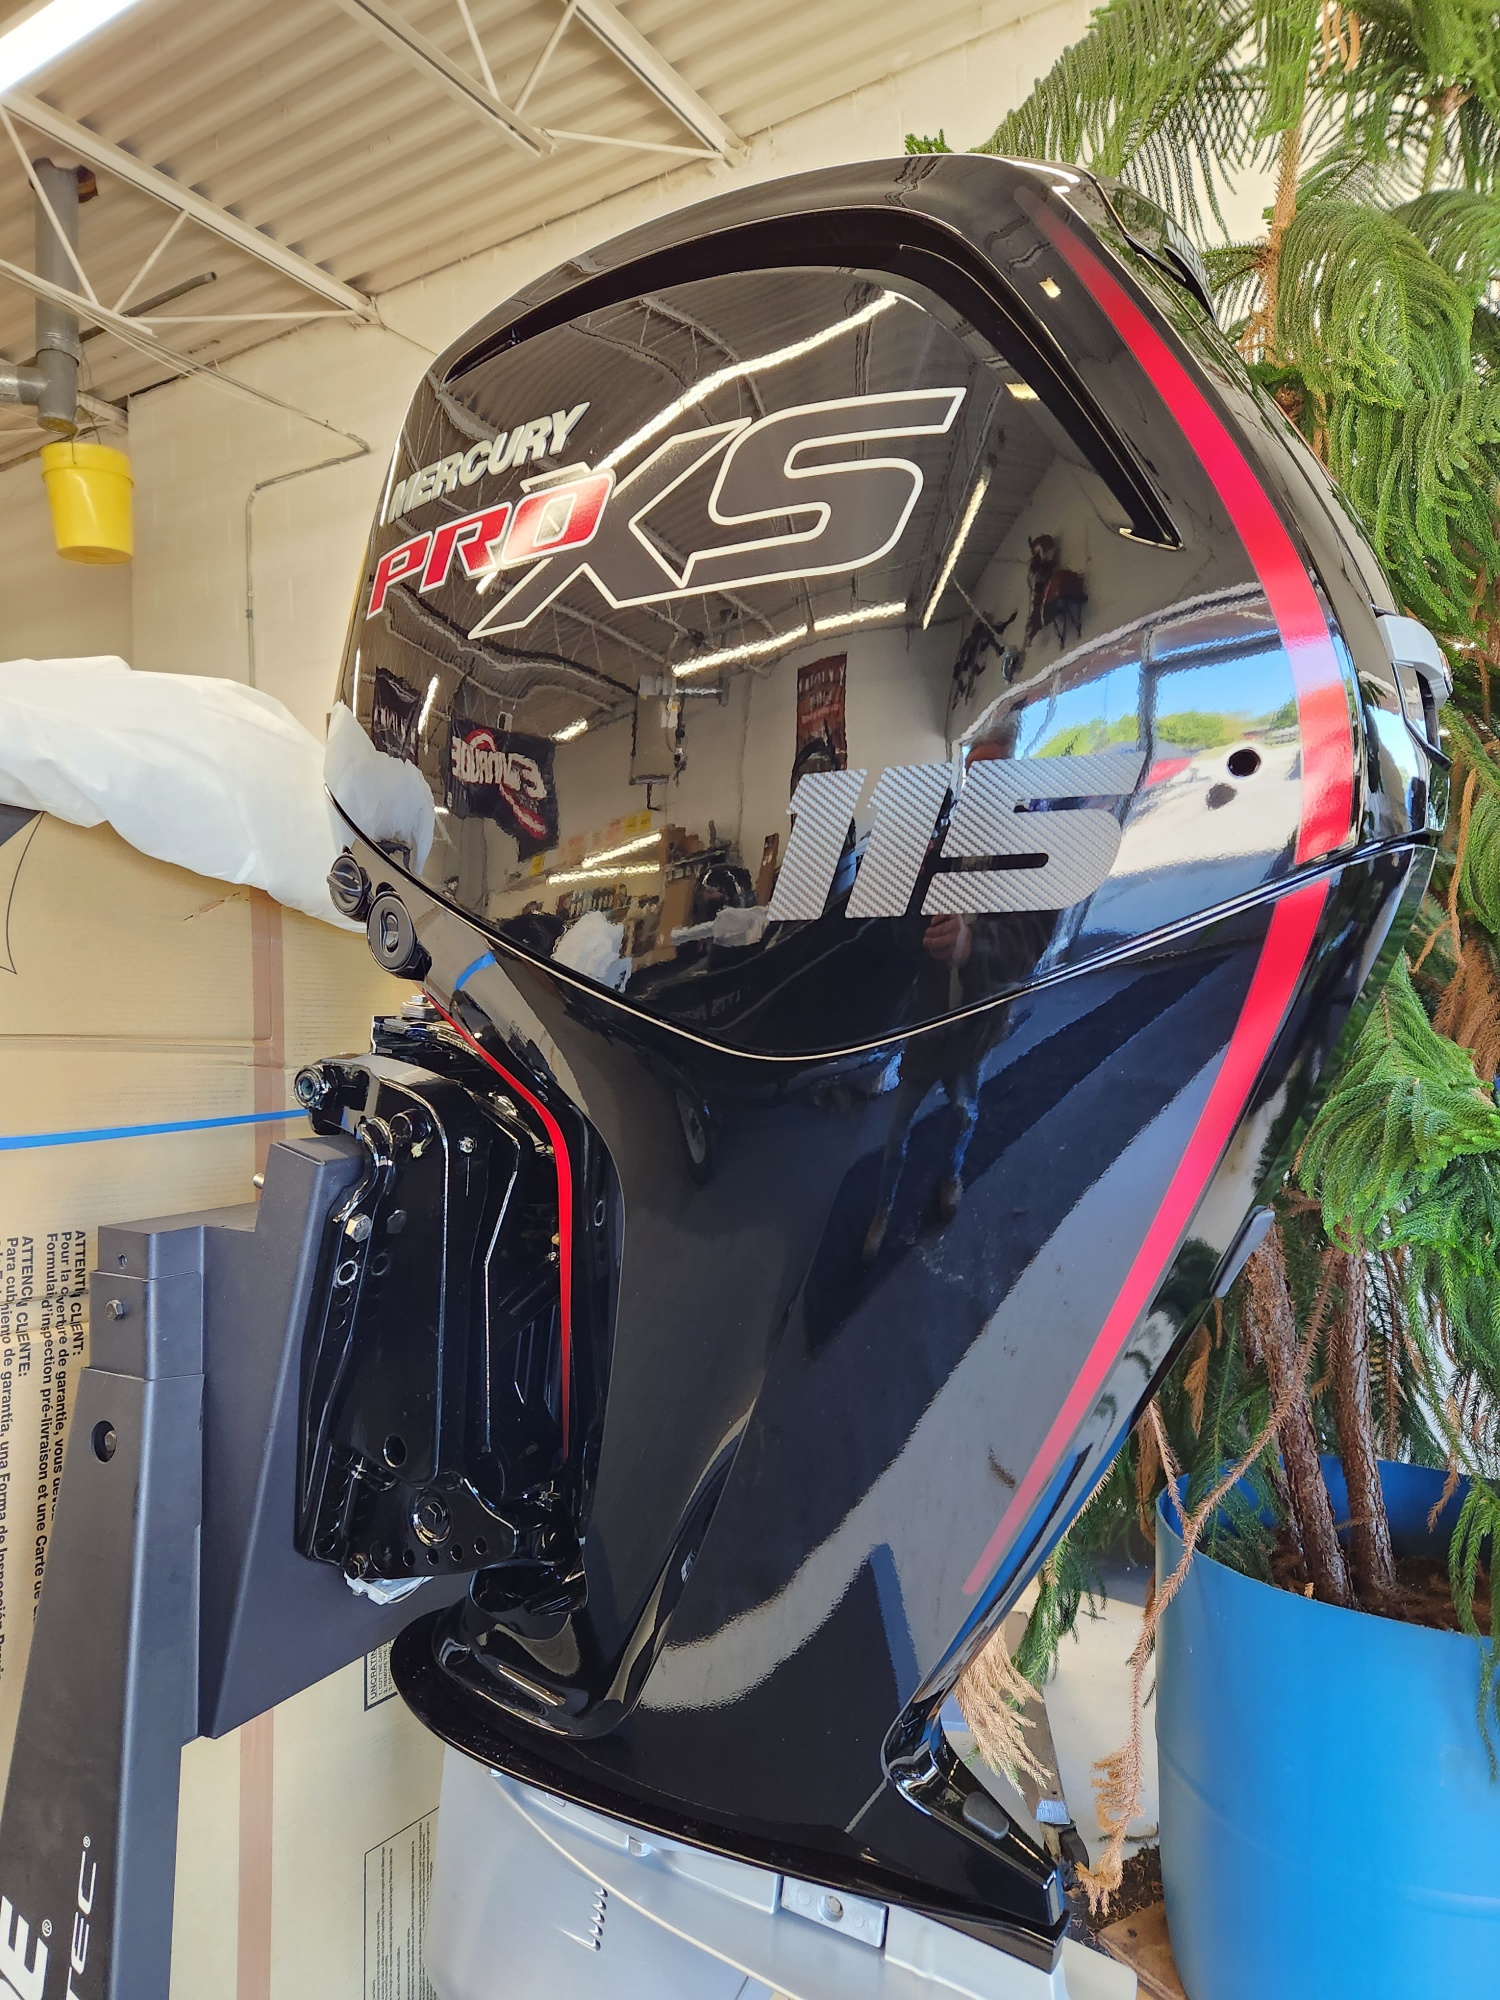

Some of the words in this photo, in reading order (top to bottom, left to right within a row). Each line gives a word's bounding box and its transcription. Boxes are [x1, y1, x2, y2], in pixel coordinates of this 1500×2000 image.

[388, 401, 591, 524] MERCURY
[467, 386, 968, 640] XS
[366, 472, 613, 621] PRO
[766, 751, 1148, 922] 115
[6, 1237, 19, 1272] Para
[60, 1231, 73, 1265] Pour
[69, 1230, 86, 1298] ATTENTIN
[60, 1269, 72, 1282] la
[3, 1348, 15, 1367] de
[16, 1312, 31, 1377] CLIENTE:
[58, 1349, 70, 1367] de
[0, 1371, 13, 1437] garantía,
[53, 1371, 67, 1436] garantie,
[0, 1441, 9, 1469] una
[38, 1387, 54, 1480] pré-livraison
[53, 1438, 64, 1474] vous
[0, 1472, 10, 1521] Forma
[37, 1484, 49, 1500] et
[36, 1503, 47, 1531] une
[34, 1535, 48, 1577] Carte
